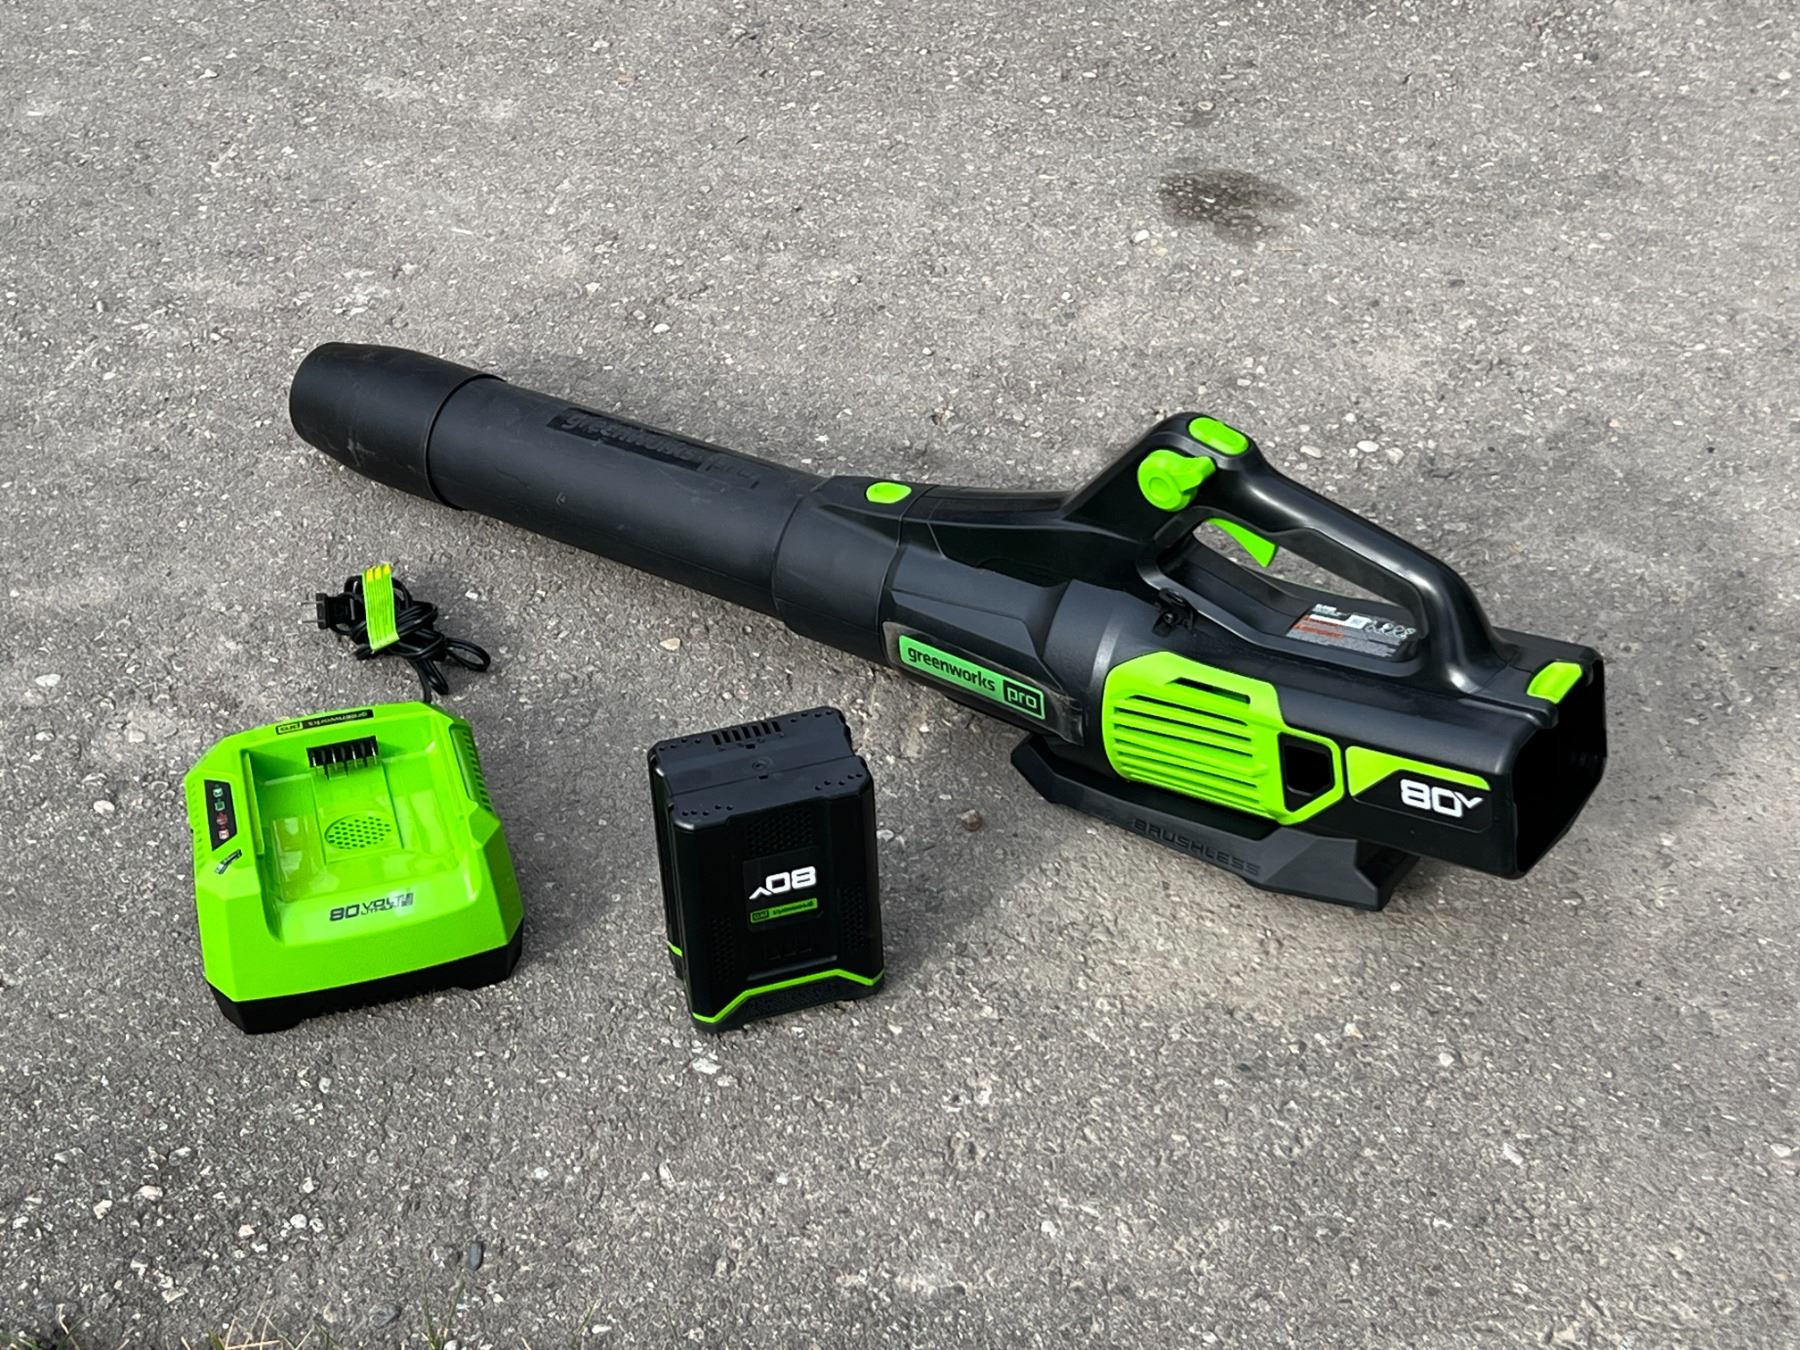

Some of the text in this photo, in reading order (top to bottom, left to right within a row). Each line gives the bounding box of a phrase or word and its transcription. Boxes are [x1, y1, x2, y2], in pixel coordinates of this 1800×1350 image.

[907, 647, 1037, 709] greenworks pro
[1400, 778, 1484, 818] 80V
[1132, 818, 1262, 877] BRUSHLESS
[329, 904, 360, 921] 80
